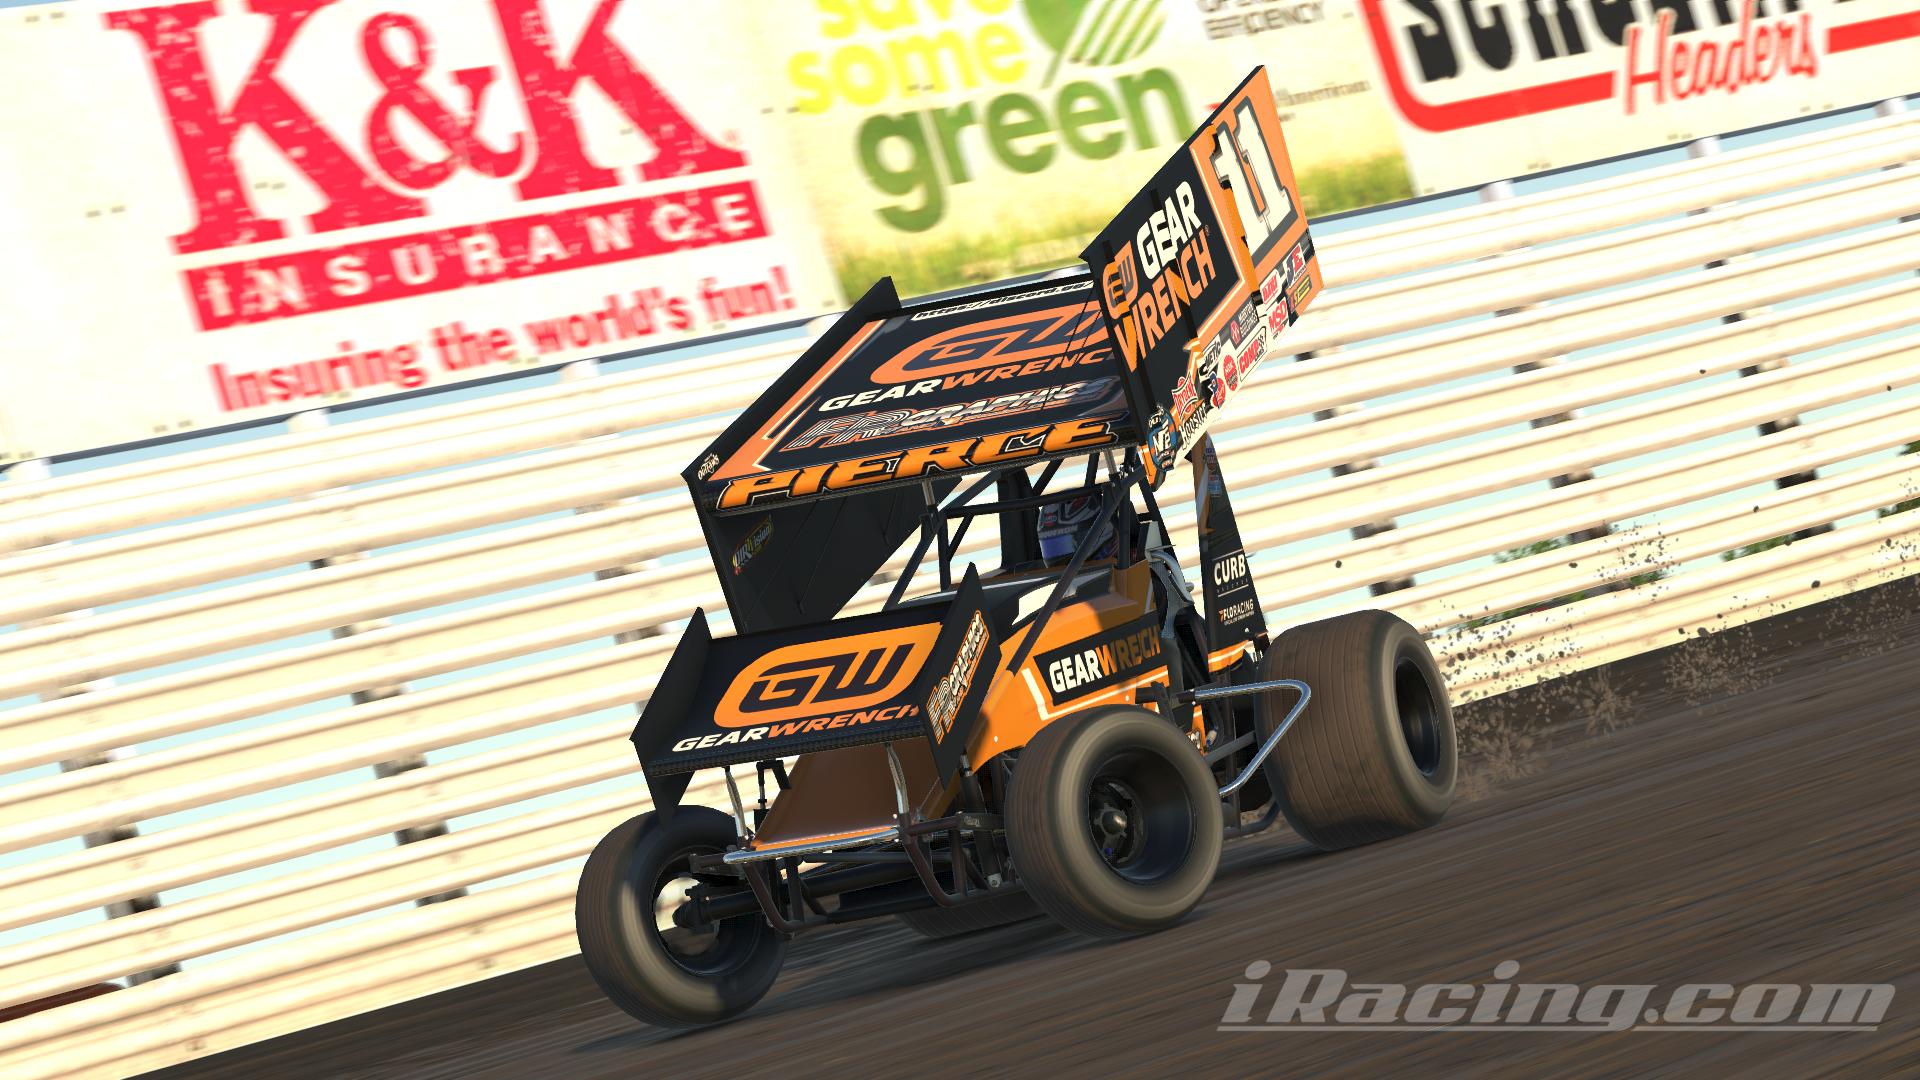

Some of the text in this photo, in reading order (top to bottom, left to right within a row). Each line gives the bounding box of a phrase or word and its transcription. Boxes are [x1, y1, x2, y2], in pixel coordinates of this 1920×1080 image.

[787, 22, 1028, 114] some
[1624, 0, 1819, 115] Headers
[103, 0, 750, 255] K&K
[855, 65, 1197, 233] green
[1136, 181, 1202, 279] GEAR
[1209, 95, 1298, 268] 11
[204, 192, 756, 319] INSURANCE
[1114, 229, 1217, 373] WRENCH
[208, 266, 798, 413] Insuring the world's fun!
[1268, 299, 1287, 332] MSD
[818, 345, 1117, 412] GEARWRENC
[717, 418, 1121, 511] PIERCE
[1213, 553, 1246, 586] CURB
[672, 704, 919, 753] GEARWRENCH
